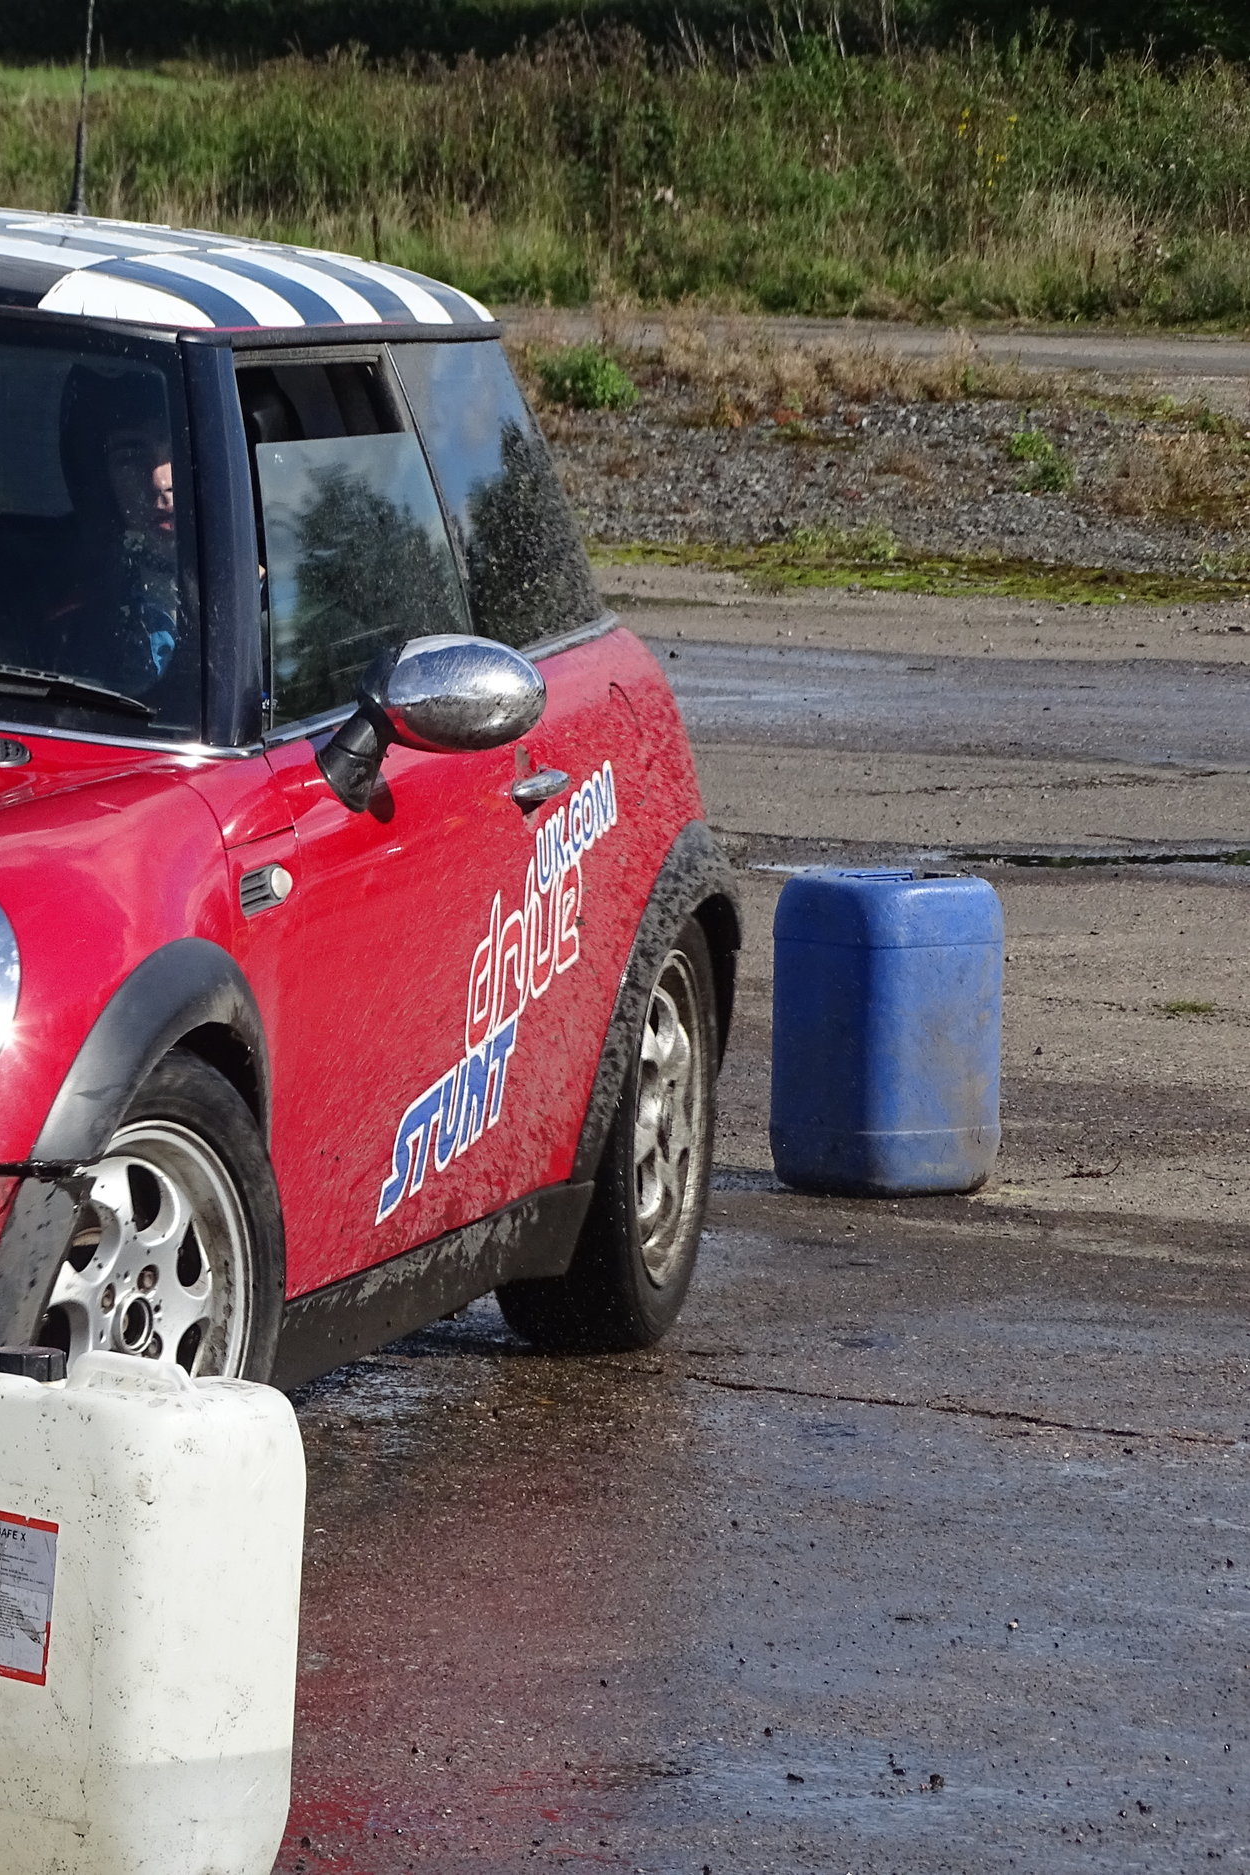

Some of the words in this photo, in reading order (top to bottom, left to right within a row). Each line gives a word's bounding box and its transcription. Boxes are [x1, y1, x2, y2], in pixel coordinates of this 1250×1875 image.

[375, 1015, 518, 1225] STUNT
[465, 857, 582, 1053] drive
[535, 760, 618, 893] UK.COM
[20, 1533, 27, 1541] X
